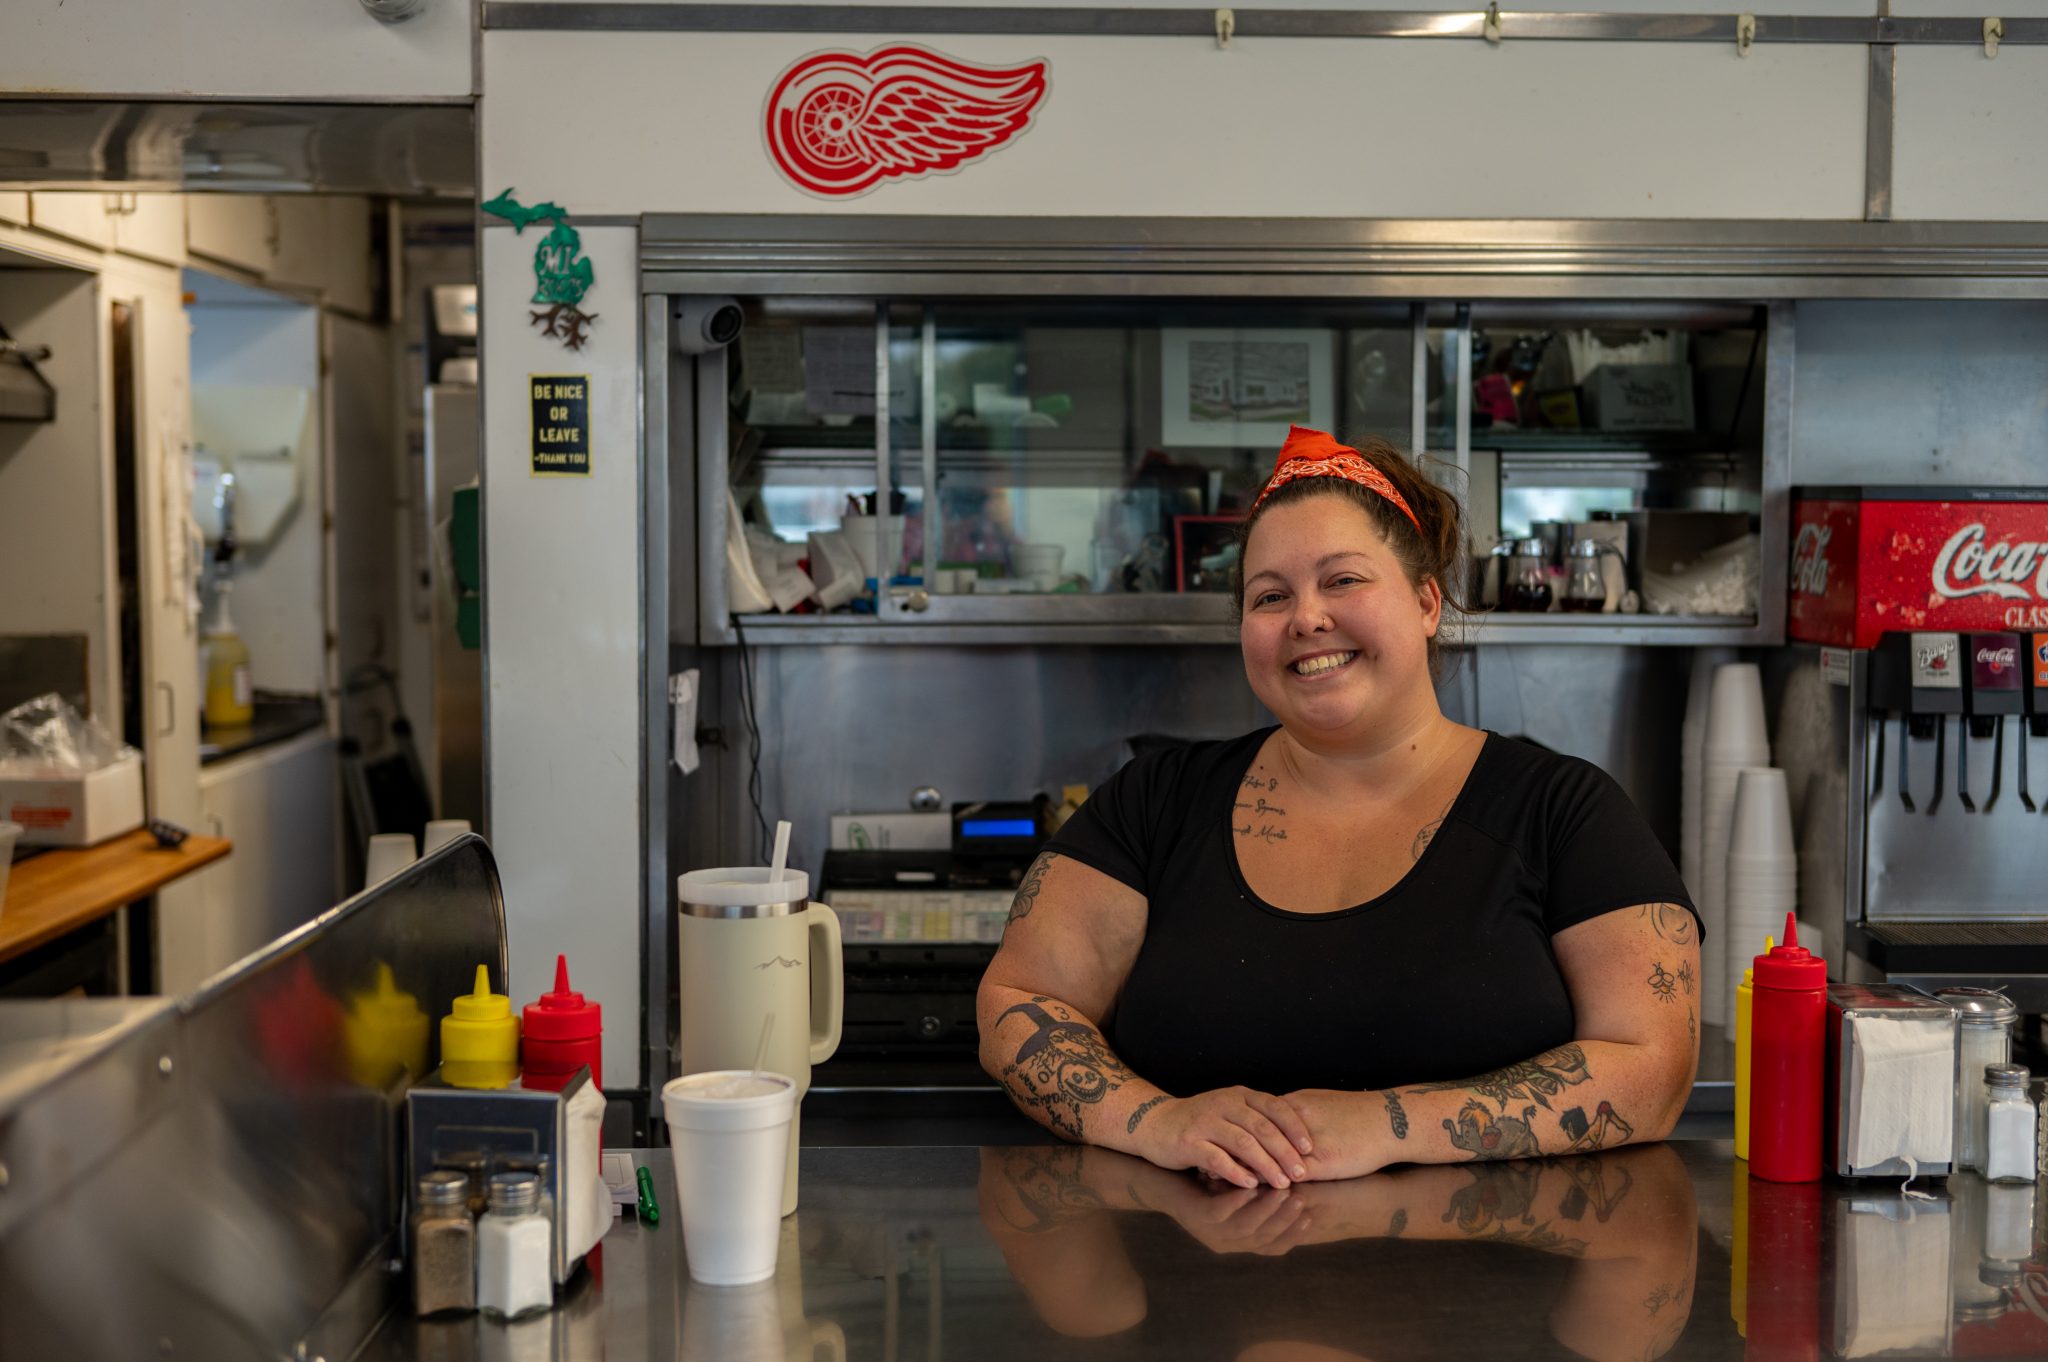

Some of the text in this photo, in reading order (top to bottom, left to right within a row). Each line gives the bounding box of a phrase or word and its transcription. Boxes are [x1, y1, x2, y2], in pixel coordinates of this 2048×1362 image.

[539, 245, 572, 275] MI
[533, 384, 584, 399] BE NICE
[549, 406, 569, 421] OR
[539, 427, 580, 442] LEAVE
[569, 453, 586, 464] YOU
